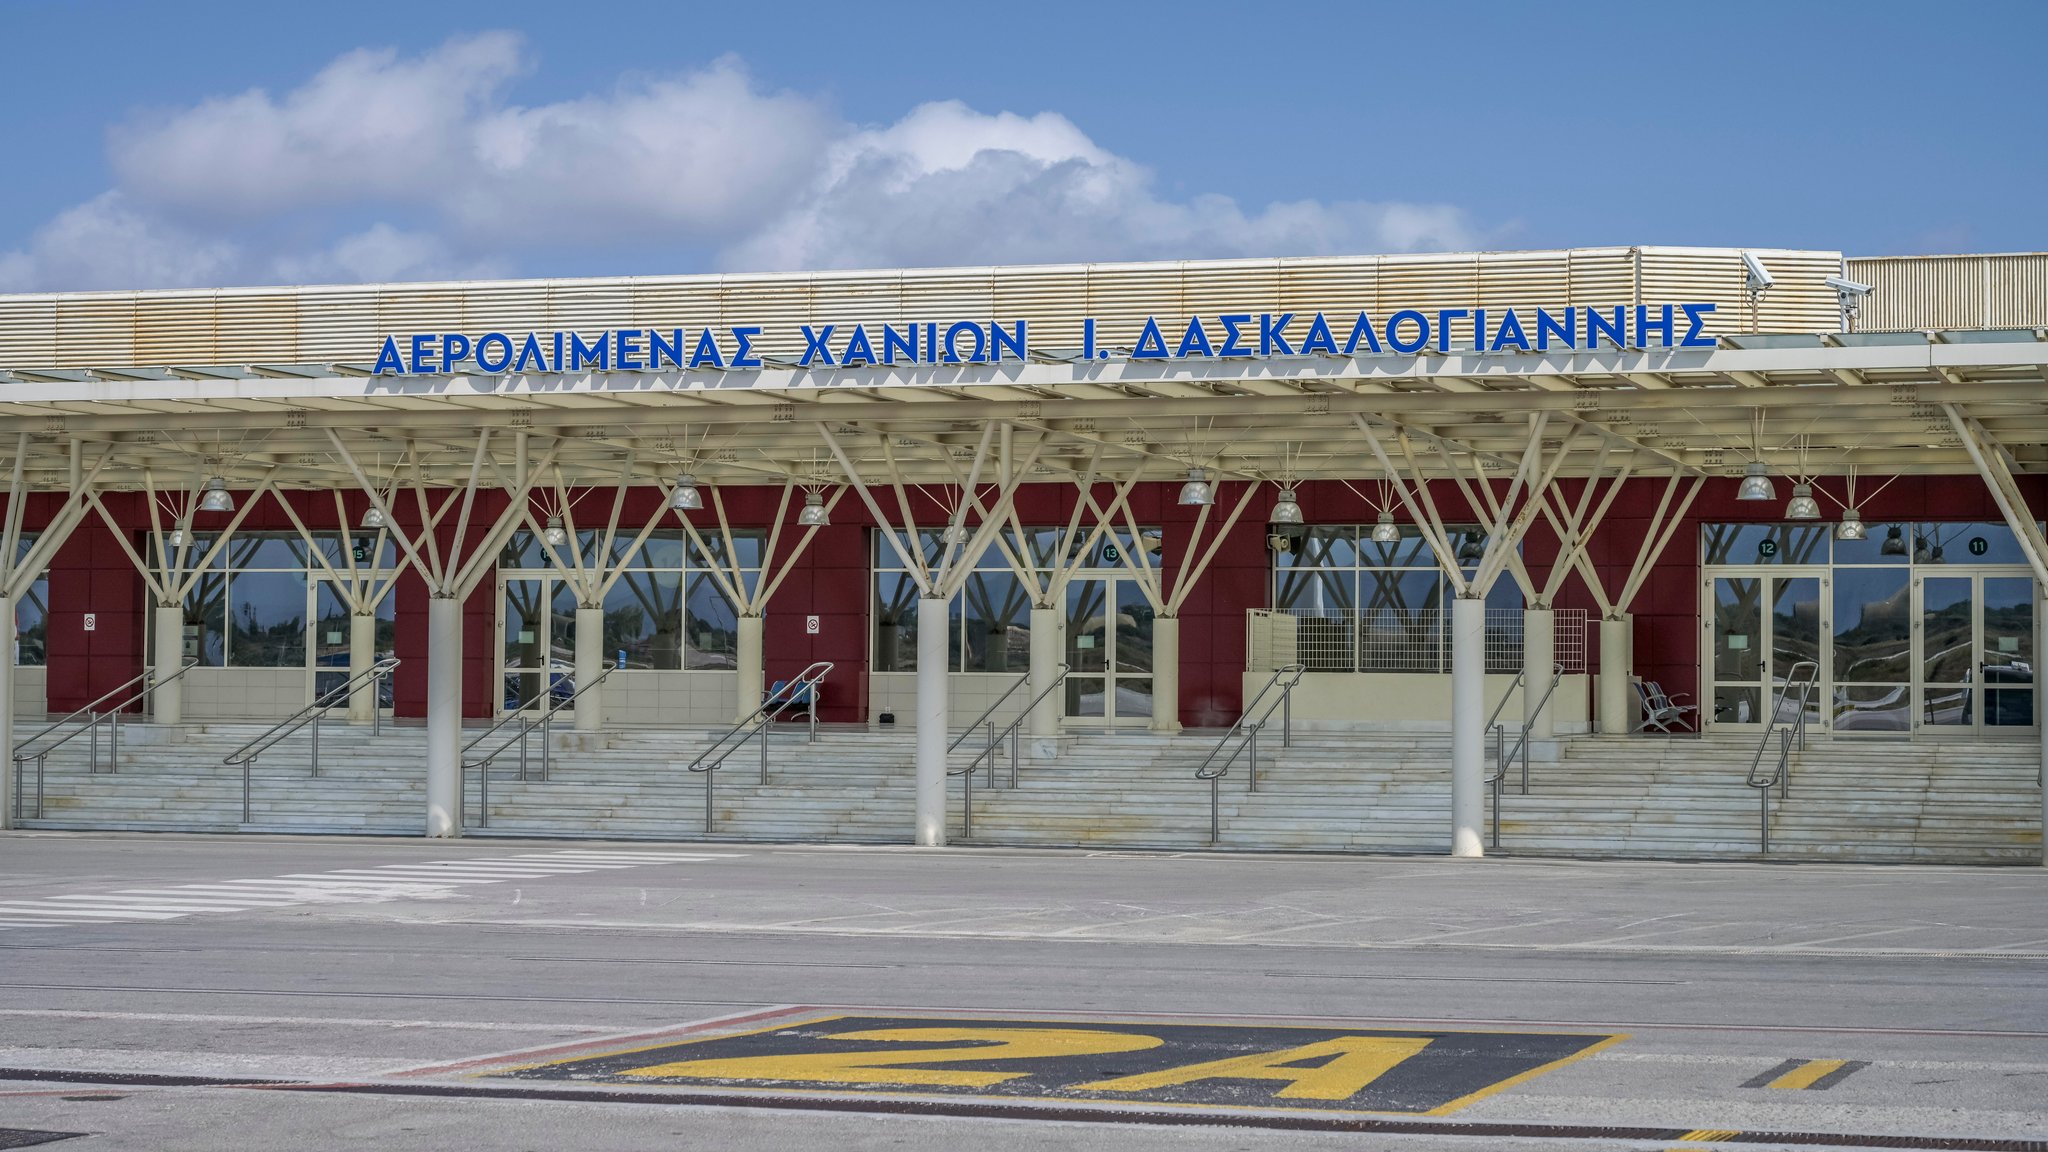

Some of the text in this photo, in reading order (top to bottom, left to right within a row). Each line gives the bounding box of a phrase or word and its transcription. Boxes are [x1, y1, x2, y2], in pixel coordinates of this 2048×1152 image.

[373, 303, 1718, 374] ΑΕΡΟΛΙΜΕΝΑΣ ΧΑΝΙΩΝ Ι. ΔΑΣΚΑΛΟΓΙΑΝΝΗΣ
[1761, 543, 1774, 554] 12
[1972, 541, 1984, 552] 11
[1105, 548, 1118, 559] 13
[620, 1027, 1431, 1101] 2A
